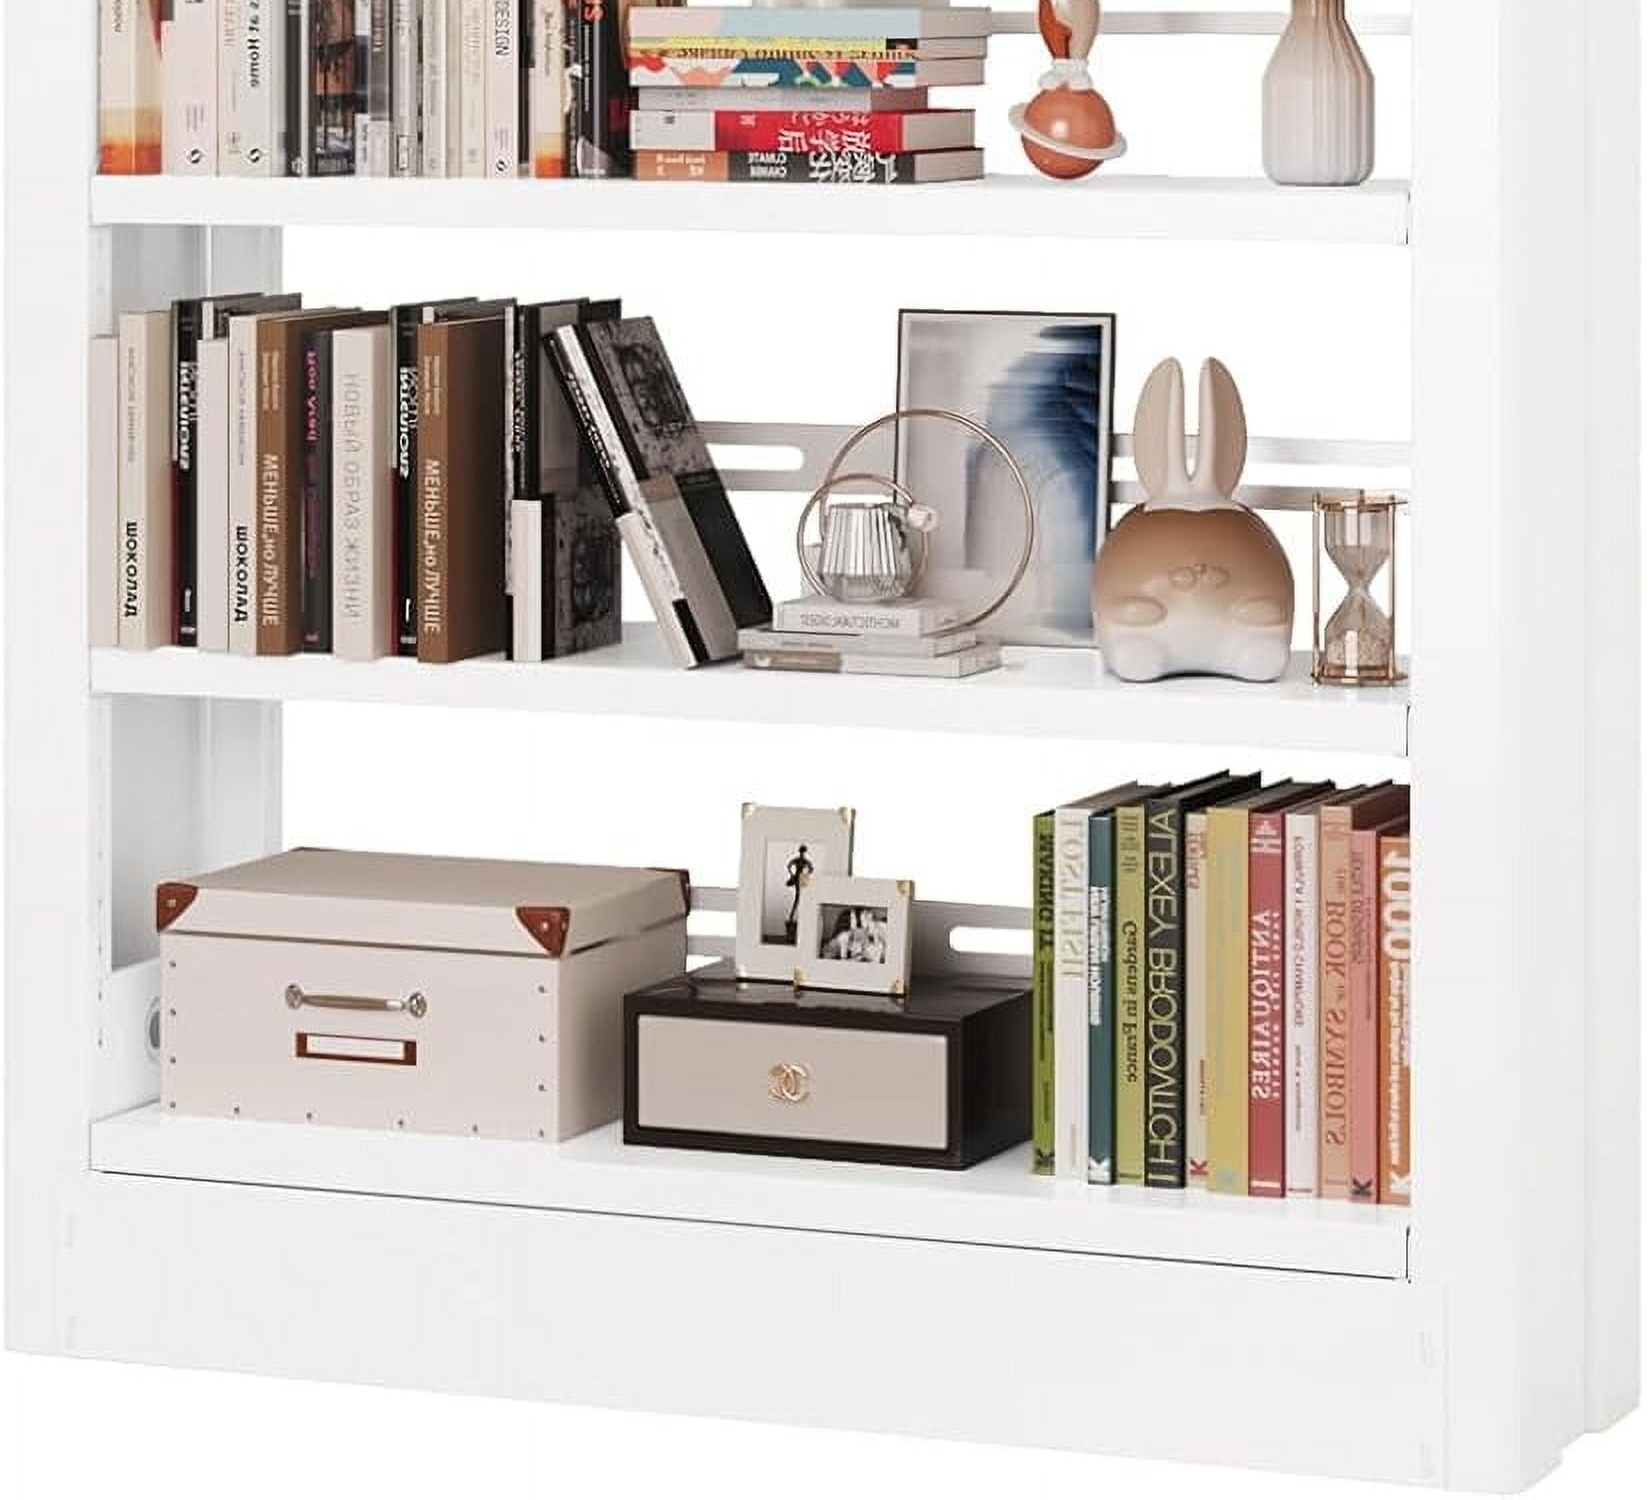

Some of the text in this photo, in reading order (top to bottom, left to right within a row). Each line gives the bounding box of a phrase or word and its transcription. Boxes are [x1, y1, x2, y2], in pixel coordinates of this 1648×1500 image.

[495, 0, 510, 57] DESIGN
[344, 373, 361, 618] НОВЫЙ ОБРАЗ ЖИЗНИ
[124, 521, 138, 618] ШОКОЛАД
[234, 525, 249, 623] ШОКОЛАД
[262, 562, 279, 627] ЛУЧШЕ
[424, 568, 440, 634] ЛУЧШЕ
